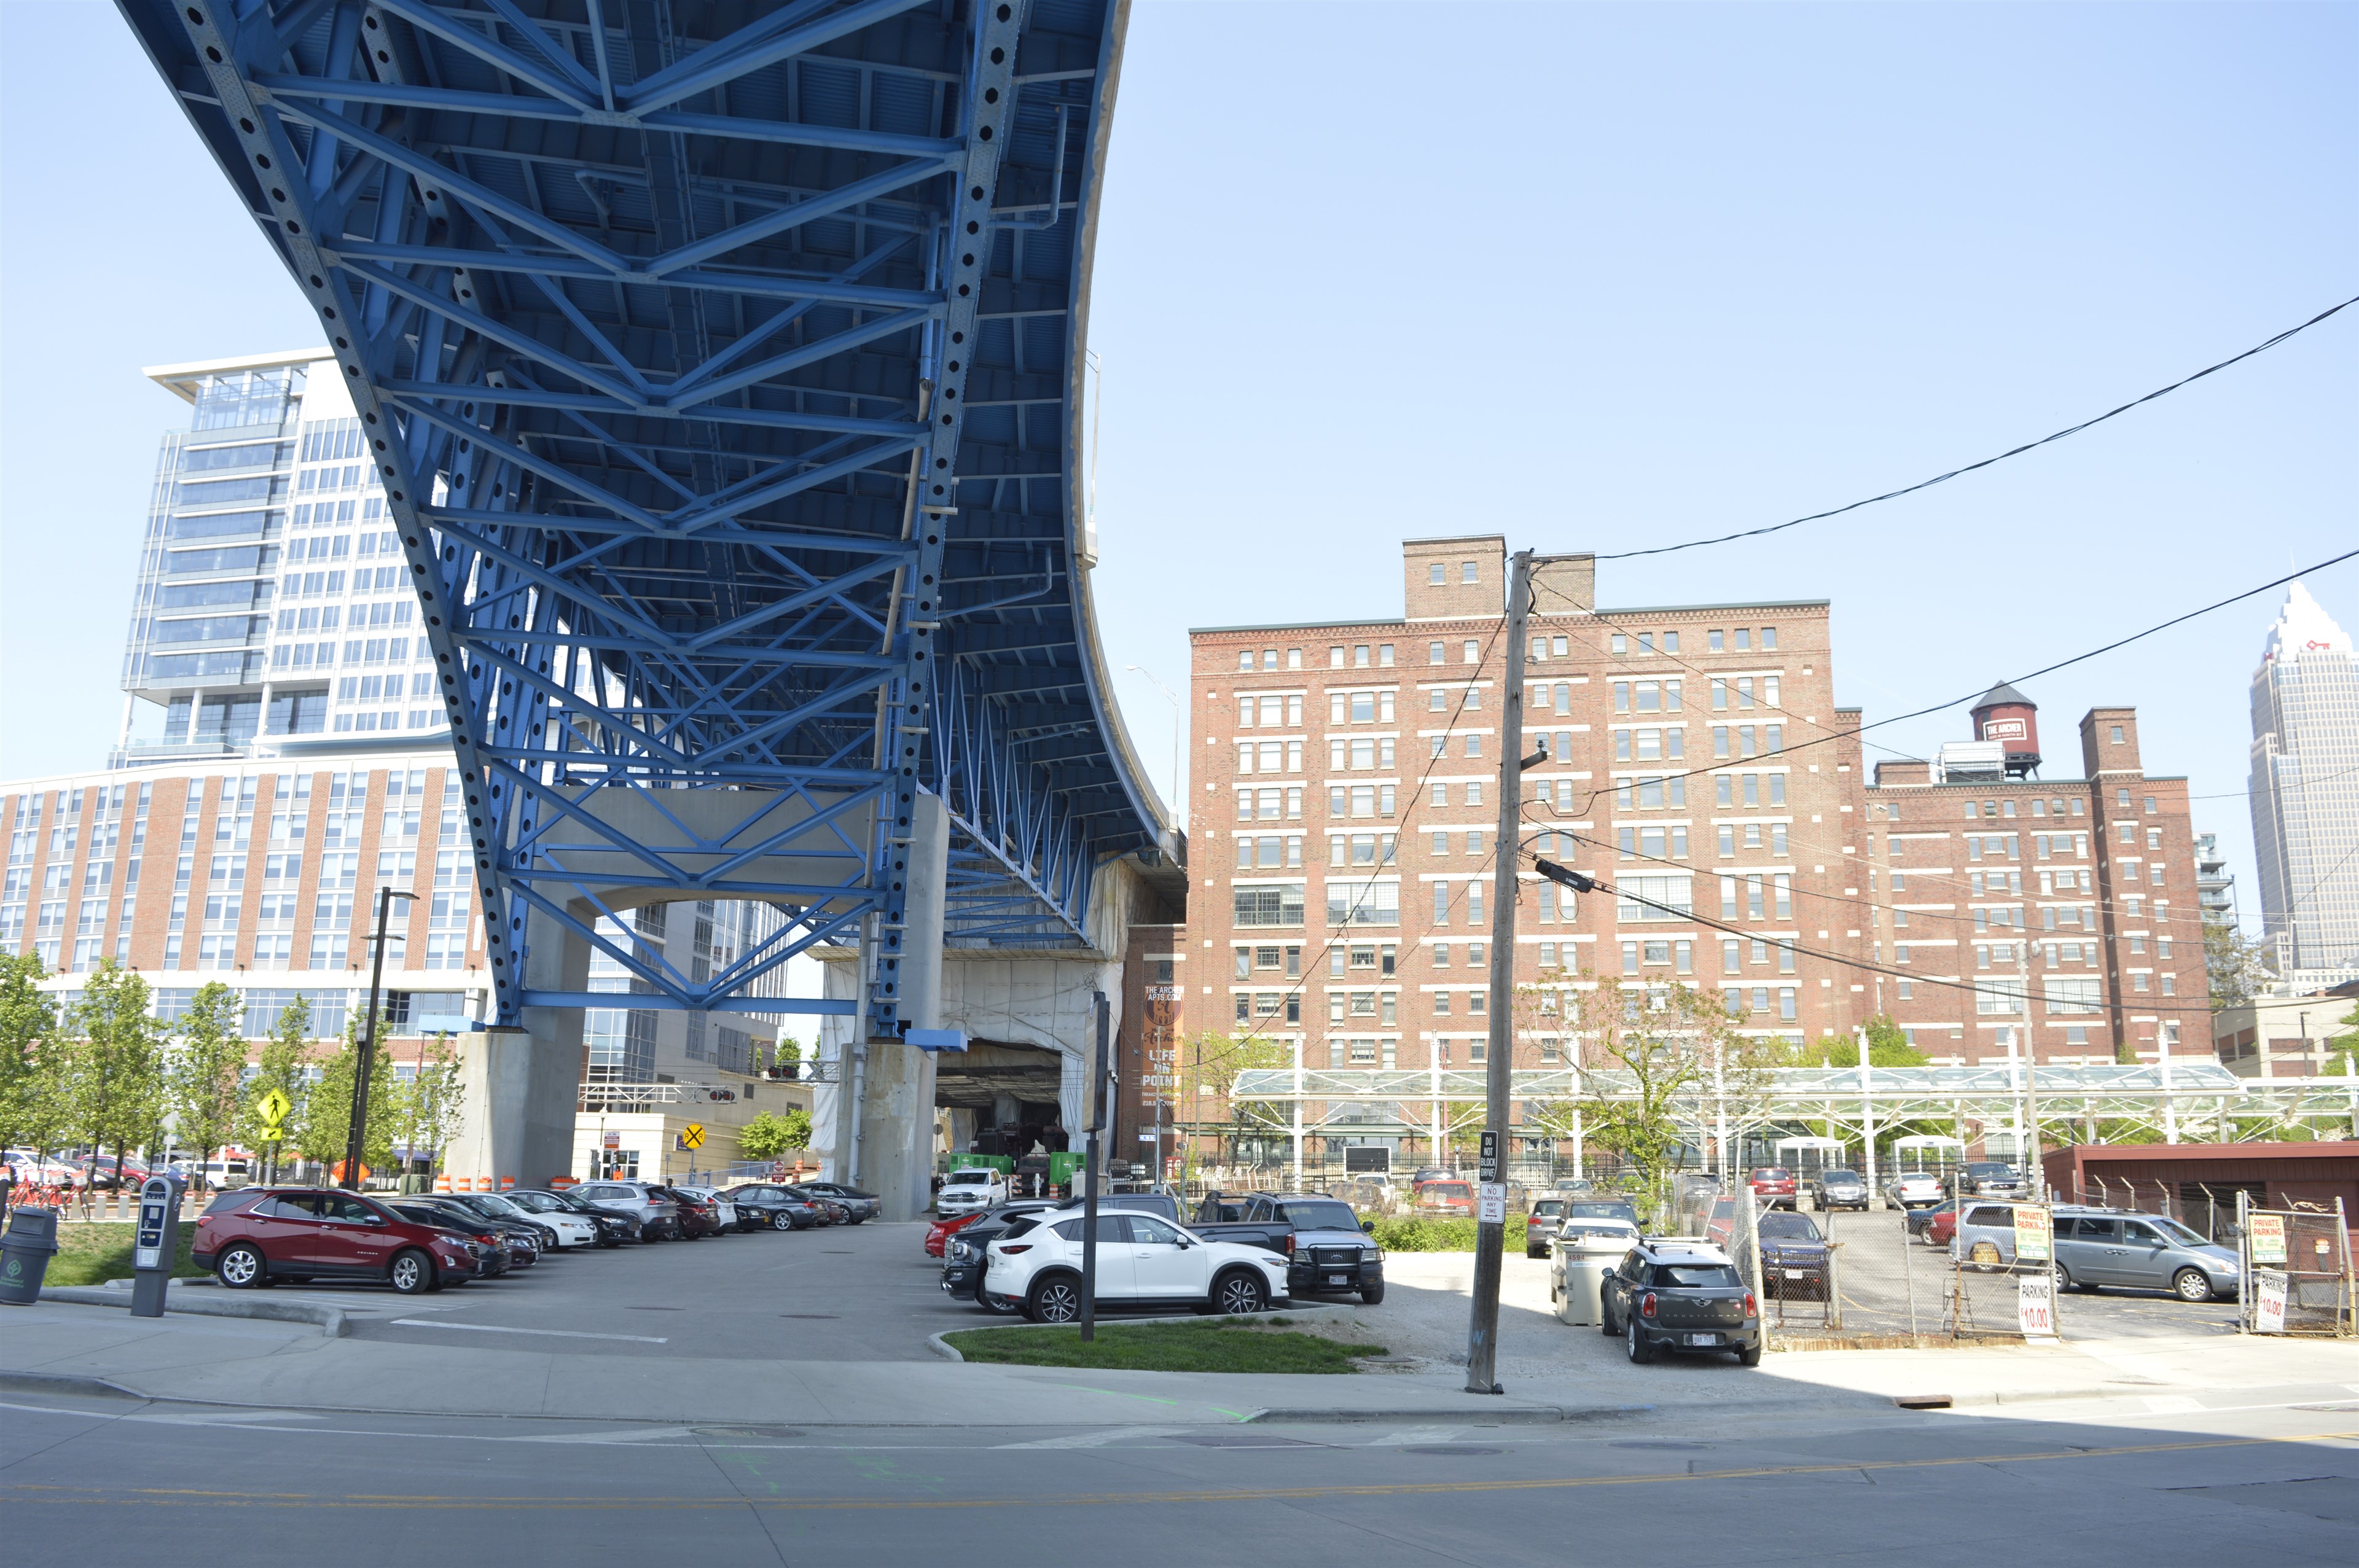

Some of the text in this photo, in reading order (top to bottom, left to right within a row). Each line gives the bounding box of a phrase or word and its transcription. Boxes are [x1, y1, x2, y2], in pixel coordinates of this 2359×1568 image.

[1987, 723, 2022, 735] THE ARCHER
[1143, 1075, 1181, 1086] POINT
[1485, 1137, 1492, 1146] DO
[1484, 1147, 1493, 1156] NOT
[1481, 1158, 1496, 1167] BLOCK
[1481, 1168, 1495, 1177] DRIVE
[2017, 1211, 2044, 1221] PRIVATE
[2017, 1220, 2046, 1231] PARKING
[2262, 1274, 2285, 1294] PARKING
[2022, 1284, 2049, 1298] PARKING
[2021, 1308, 2048, 1328] $10.00
